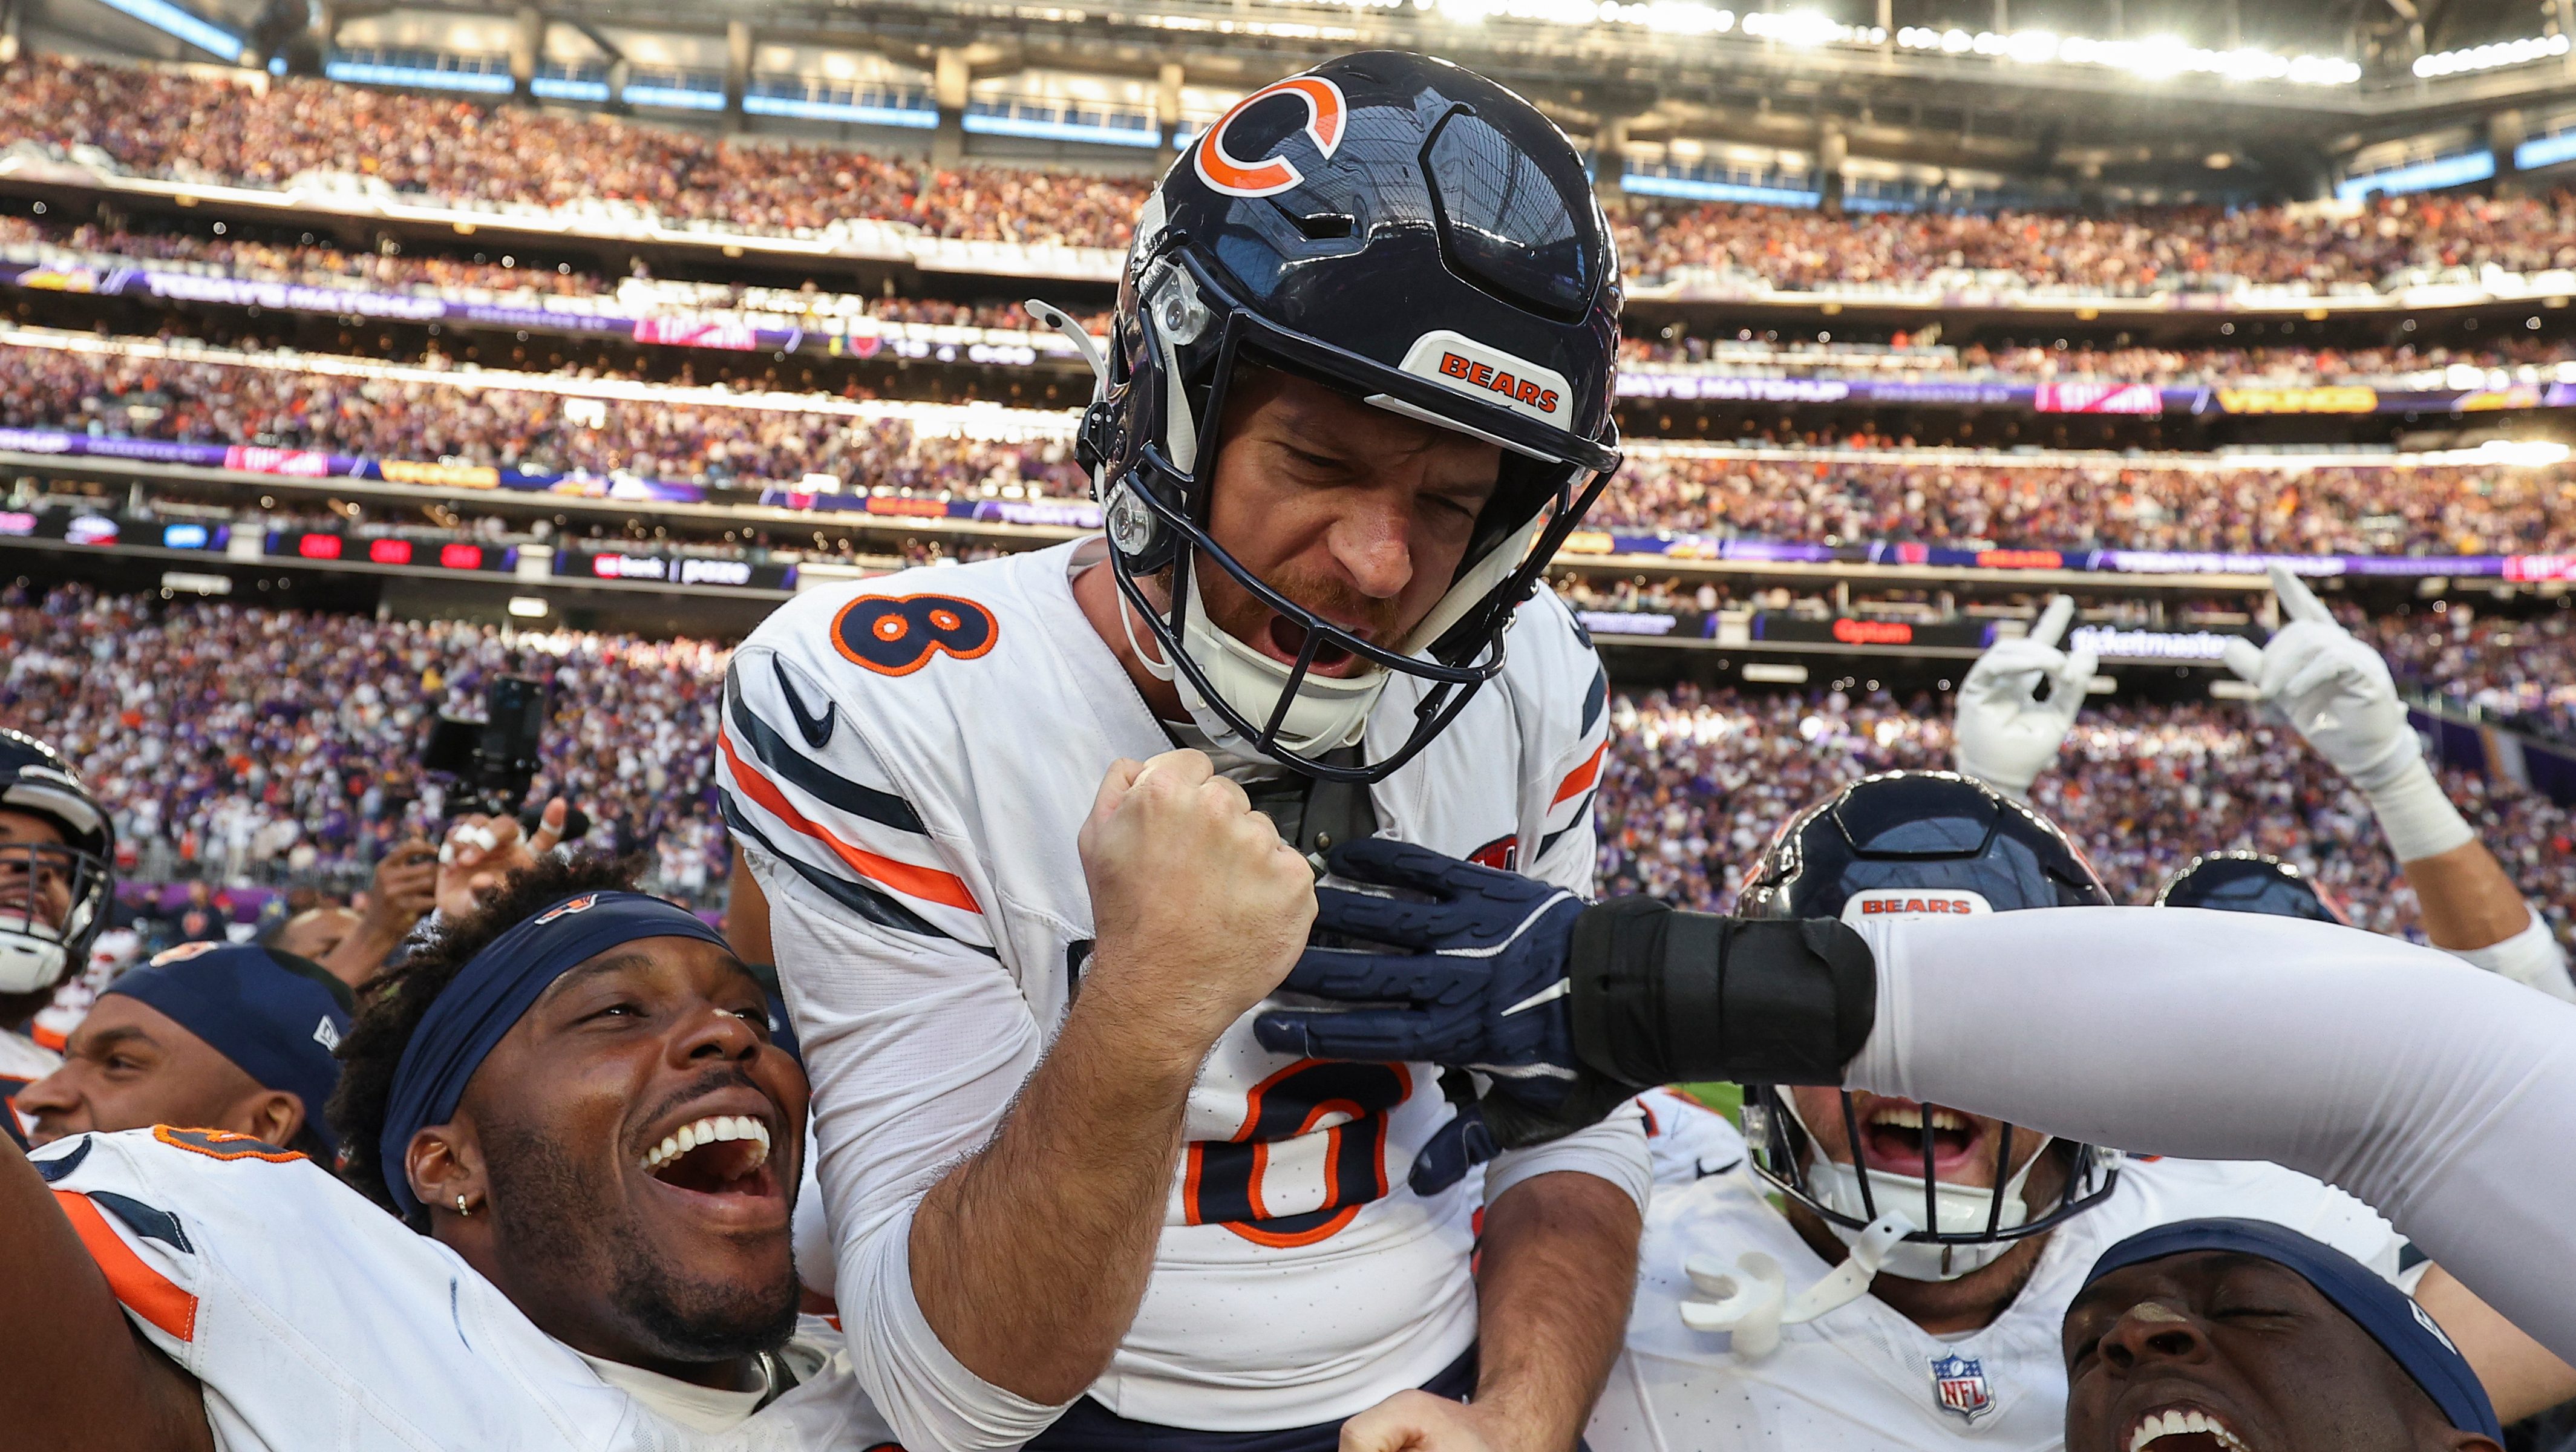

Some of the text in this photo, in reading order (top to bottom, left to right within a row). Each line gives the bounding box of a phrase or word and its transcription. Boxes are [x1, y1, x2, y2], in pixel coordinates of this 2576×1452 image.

[1193, 76, 1347, 198] C
[1439, 352, 1559, 413] BEARS
[829, 592, 999, 677] 8
[1862, 899, 1972, 914] BEARS
[1941, 1379, 1986, 1408] NFL
